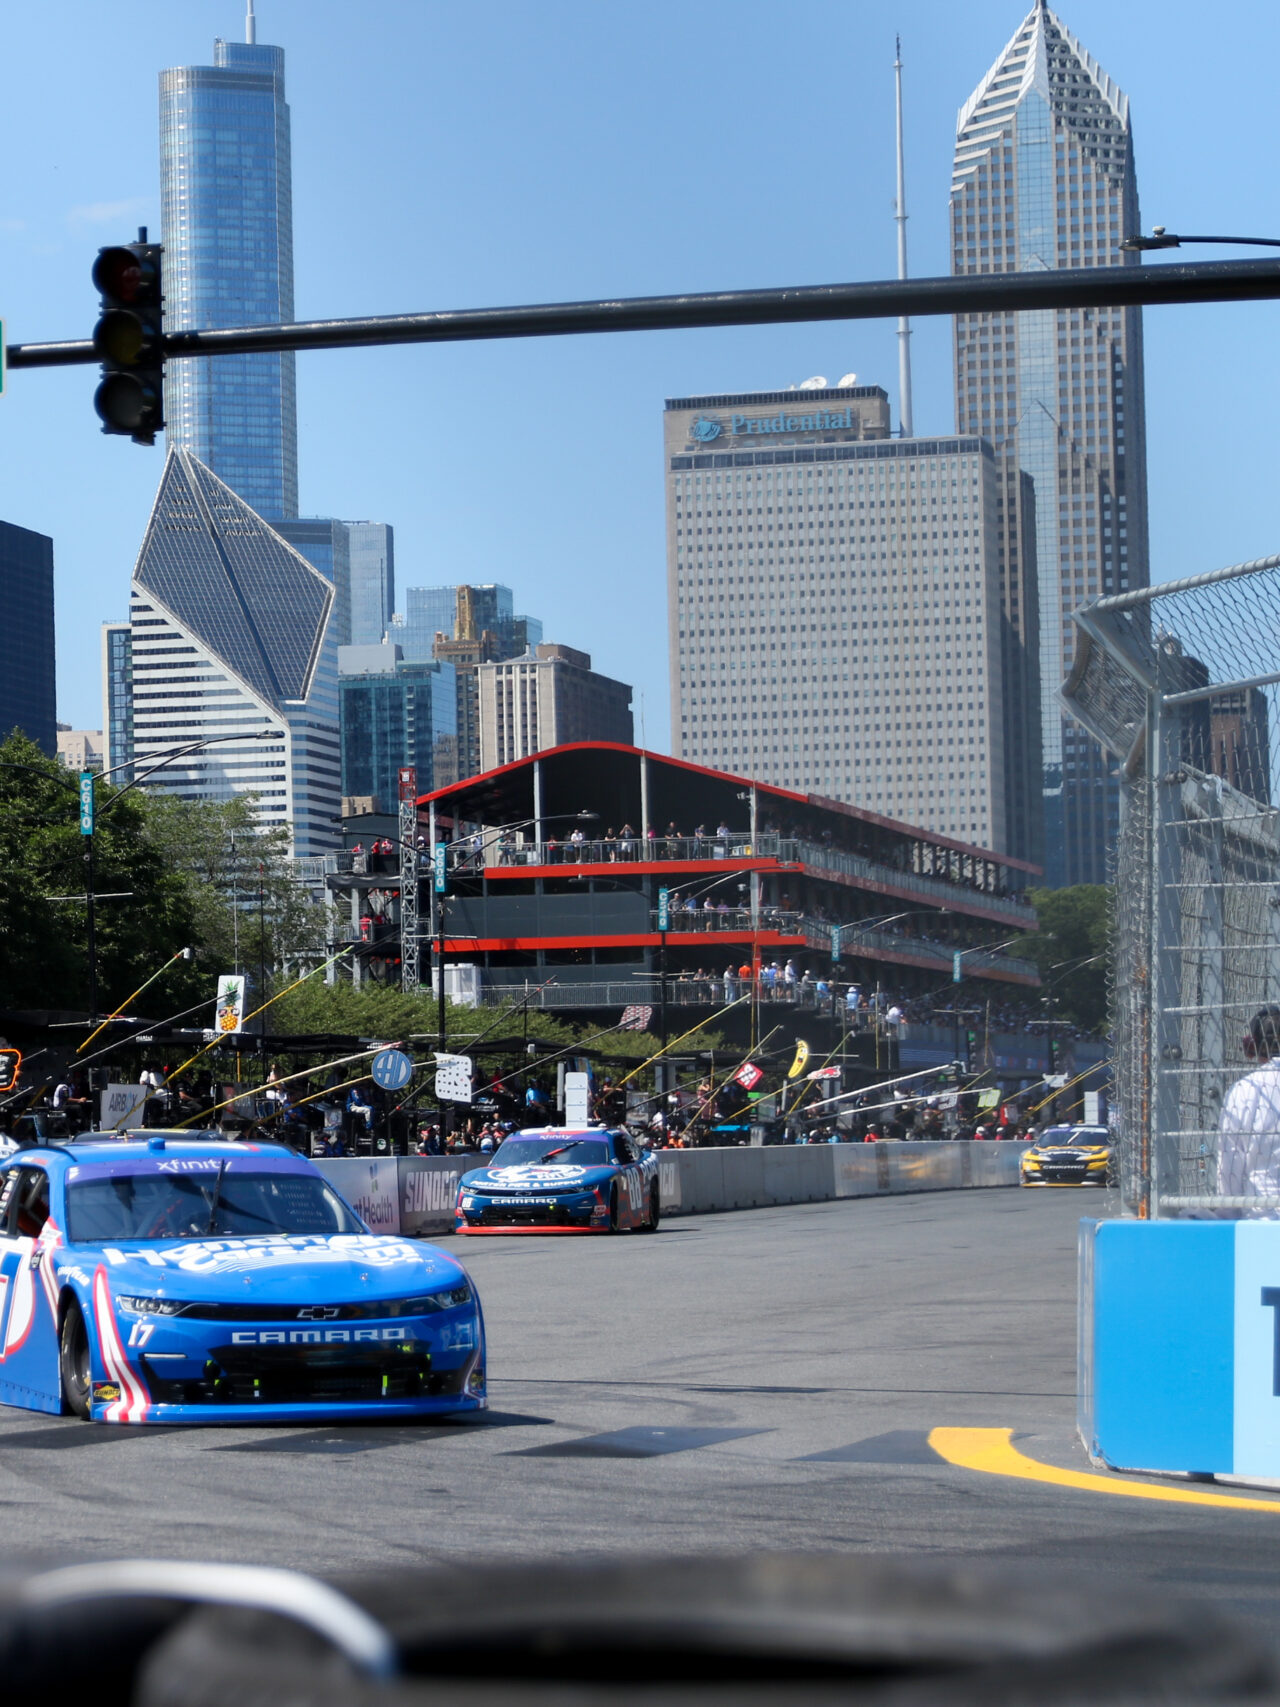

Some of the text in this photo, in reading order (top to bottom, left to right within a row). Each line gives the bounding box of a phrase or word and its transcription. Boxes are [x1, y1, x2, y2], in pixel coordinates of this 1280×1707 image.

[731, 407, 853, 435] Prudential
[81, 779, 91, 829] C610
[539, 1133, 571, 1141] xfinity
[156, 1157, 233, 1173] xfinity
[405, 1170, 458, 1213] SUNOCO
[102, 1234, 405, 1267] Hendrick
[128, 1323, 155, 1347] 17
[231, 1327, 405, 1344] CAMARO
[93, 1387, 121, 1398] SUNOCO
